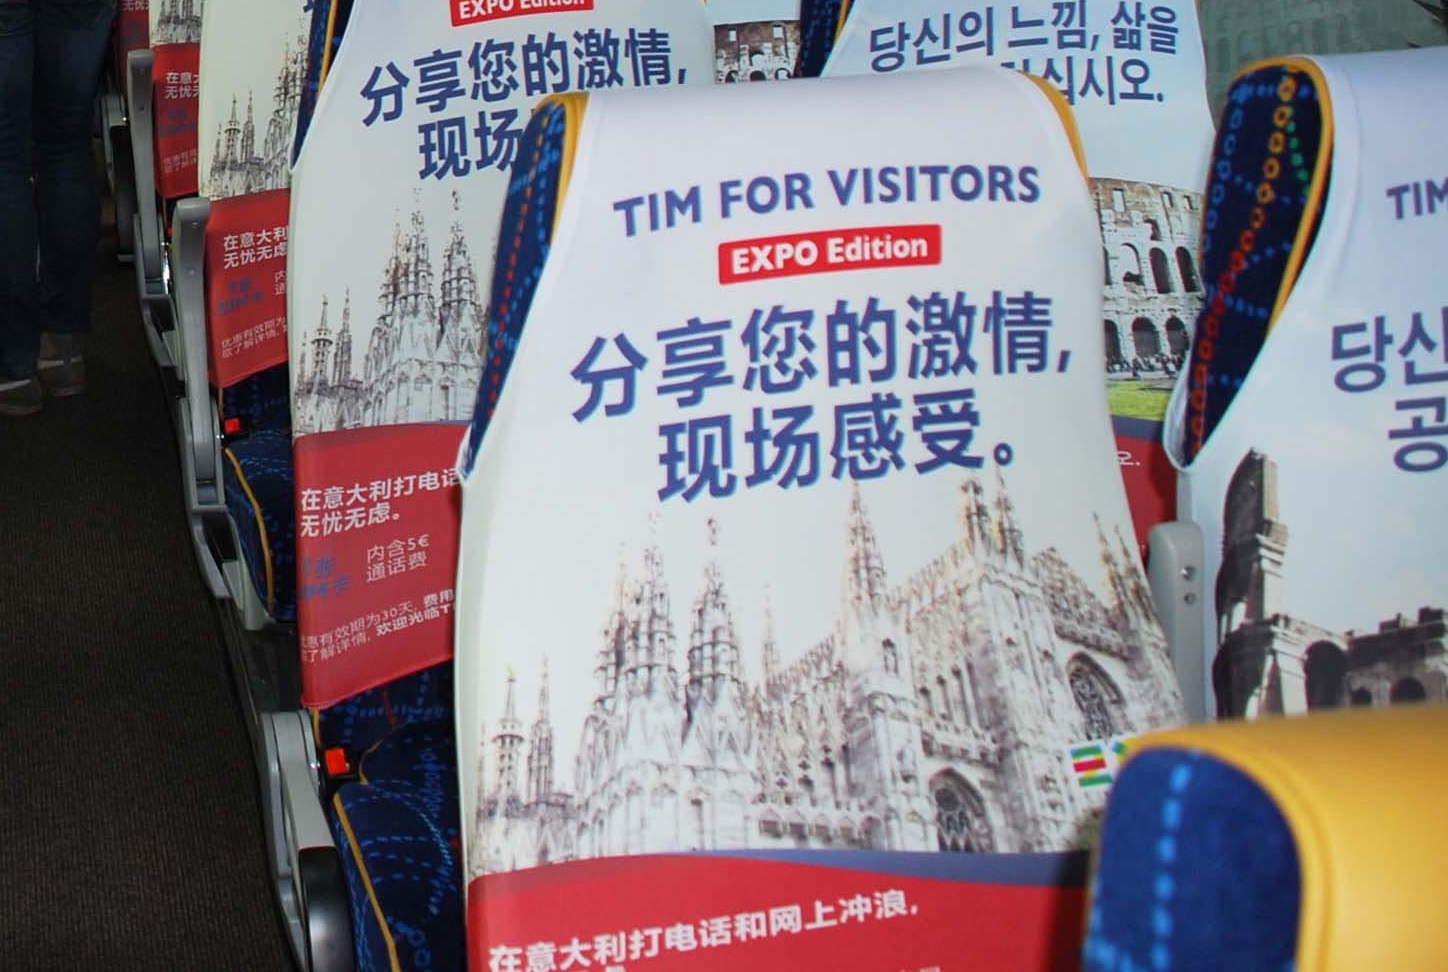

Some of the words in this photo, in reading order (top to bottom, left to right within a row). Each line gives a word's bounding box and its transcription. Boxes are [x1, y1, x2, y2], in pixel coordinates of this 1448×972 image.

[870, 6, 994, 73] 당신의
[1007, 0, 1099, 52] 느낌,
[1111, 0, 1179, 55] 삶을
[614, 184, 702, 236] TIM
[719, 173, 814, 219] FOR
[827, 165, 1041, 207] VISITORS
[1386, 178, 1448, 220] TIM
[731, 240, 818, 275] EXPO
[826, 232, 928, 264] Edition
[1331, 306, 1448, 393] 당신
[658, 388, 1014, 502] 现场感受。
[301, 502, 400, 538] 无忧无虑。
[366, 553, 428, 583] 通话费
